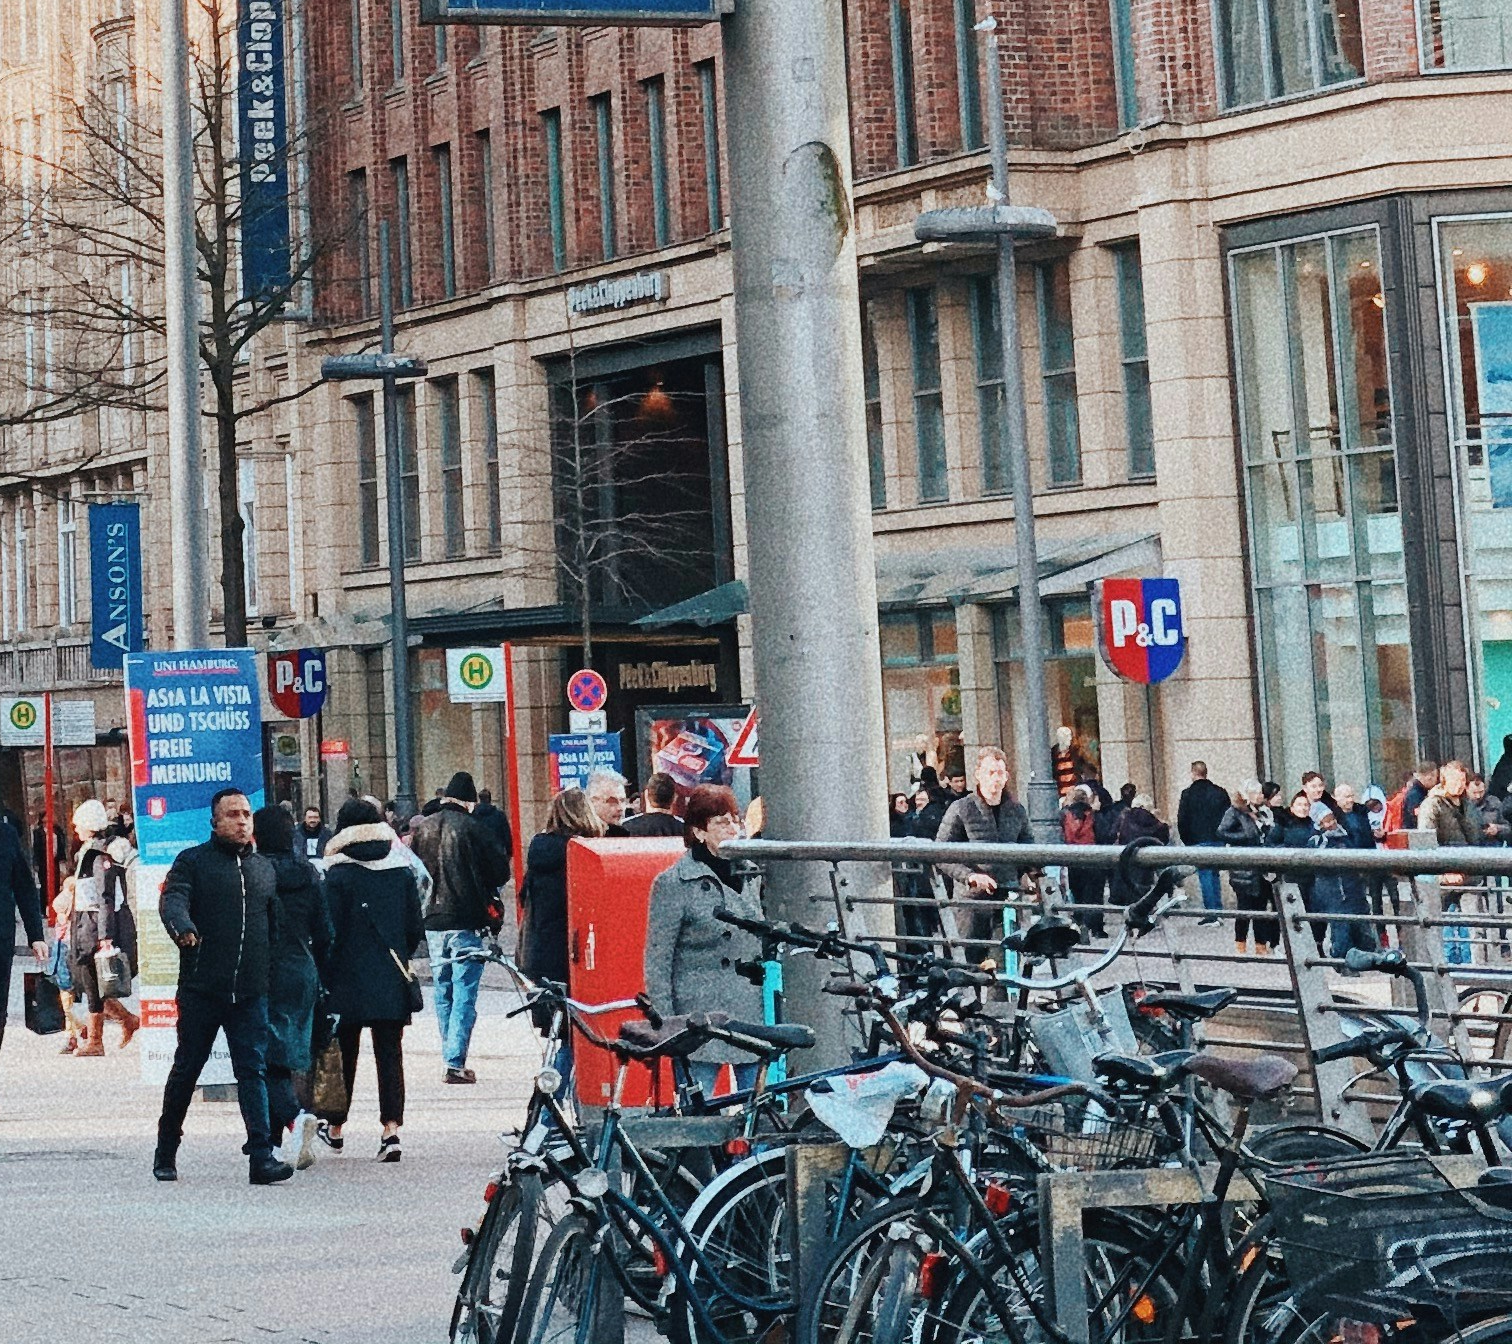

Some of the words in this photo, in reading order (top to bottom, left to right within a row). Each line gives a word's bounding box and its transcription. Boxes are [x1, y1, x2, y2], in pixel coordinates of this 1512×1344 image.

[1110, 599, 1178, 647] P&C
[154, 661, 177, 672] UNI
[275, 660, 323, 694] P&C
[190, 686, 210, 706] LA
[213, 684, 251, 705] VISTA
[148, 713, 185, 734] UND
[188, 706, 250, 731] TSCHÜSS
[149, 738, 193, 759] FREIE
[152, 762, 231, 785] MEINUNG!
